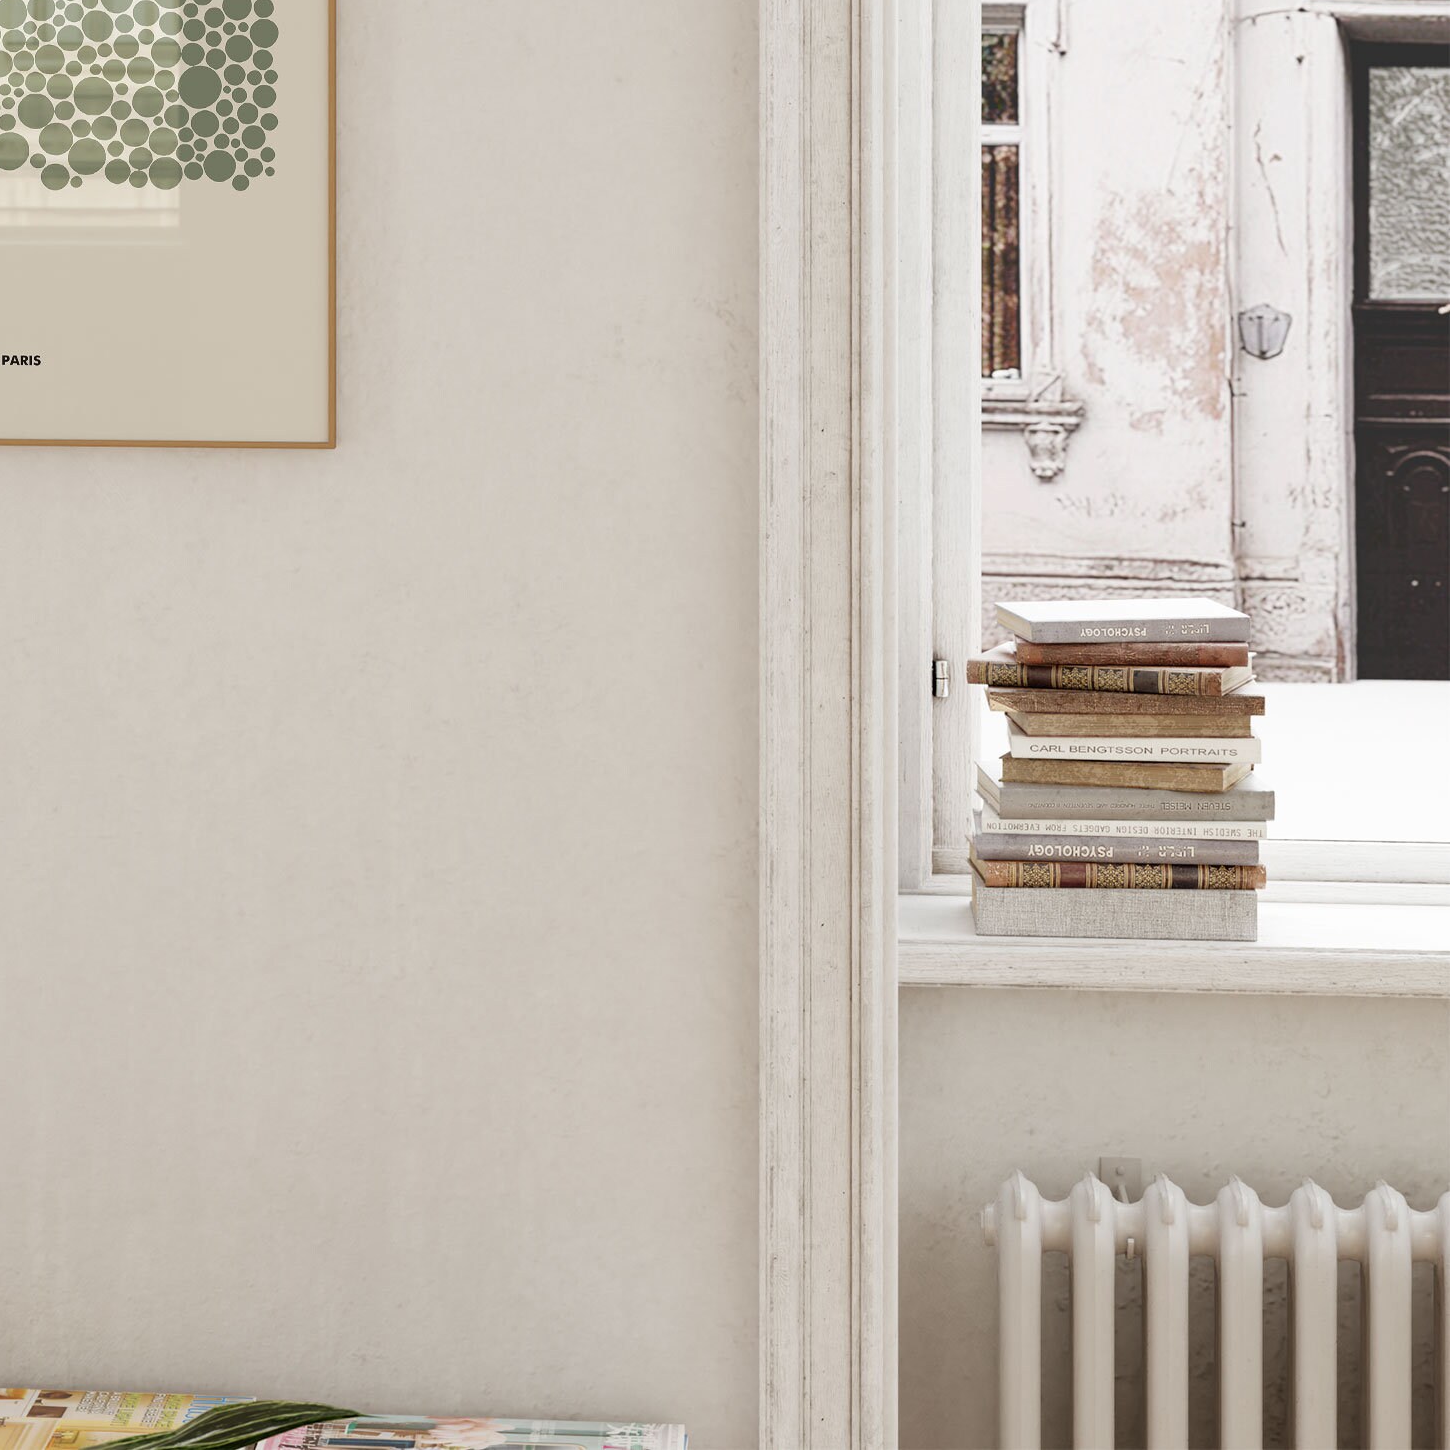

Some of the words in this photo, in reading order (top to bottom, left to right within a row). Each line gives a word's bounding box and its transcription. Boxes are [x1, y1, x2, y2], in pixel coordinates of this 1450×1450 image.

[1, 354, 42, 367] PARIS
[1080, 627, 1147, 637] PSYCHOLOGY
[1029, 744, 1065, 753] CARL
[1068, 745, 1153, 755] BENGTSSON
[1160, 747, 1238, 757] PORTRAITS
[1160, 802, 1192, 810] MEISEL
[1197, 802, 1231, 810] STEVEN
[986, 822, 1040, 831] EVERMOTION
[1045, 823, 1067, 832] FROM
[1073, 824, 1110, 833] GADGETS
[1116, 825, 1149, 835] DESIGN
[1153, 827, 1197, 836] INTERIOR
[1203, 828, 1241, 837] SWEDISH
[1247, 829, 1263, 838] THE
[1028, 844, 1114, 858] PSYCHOLOGY
